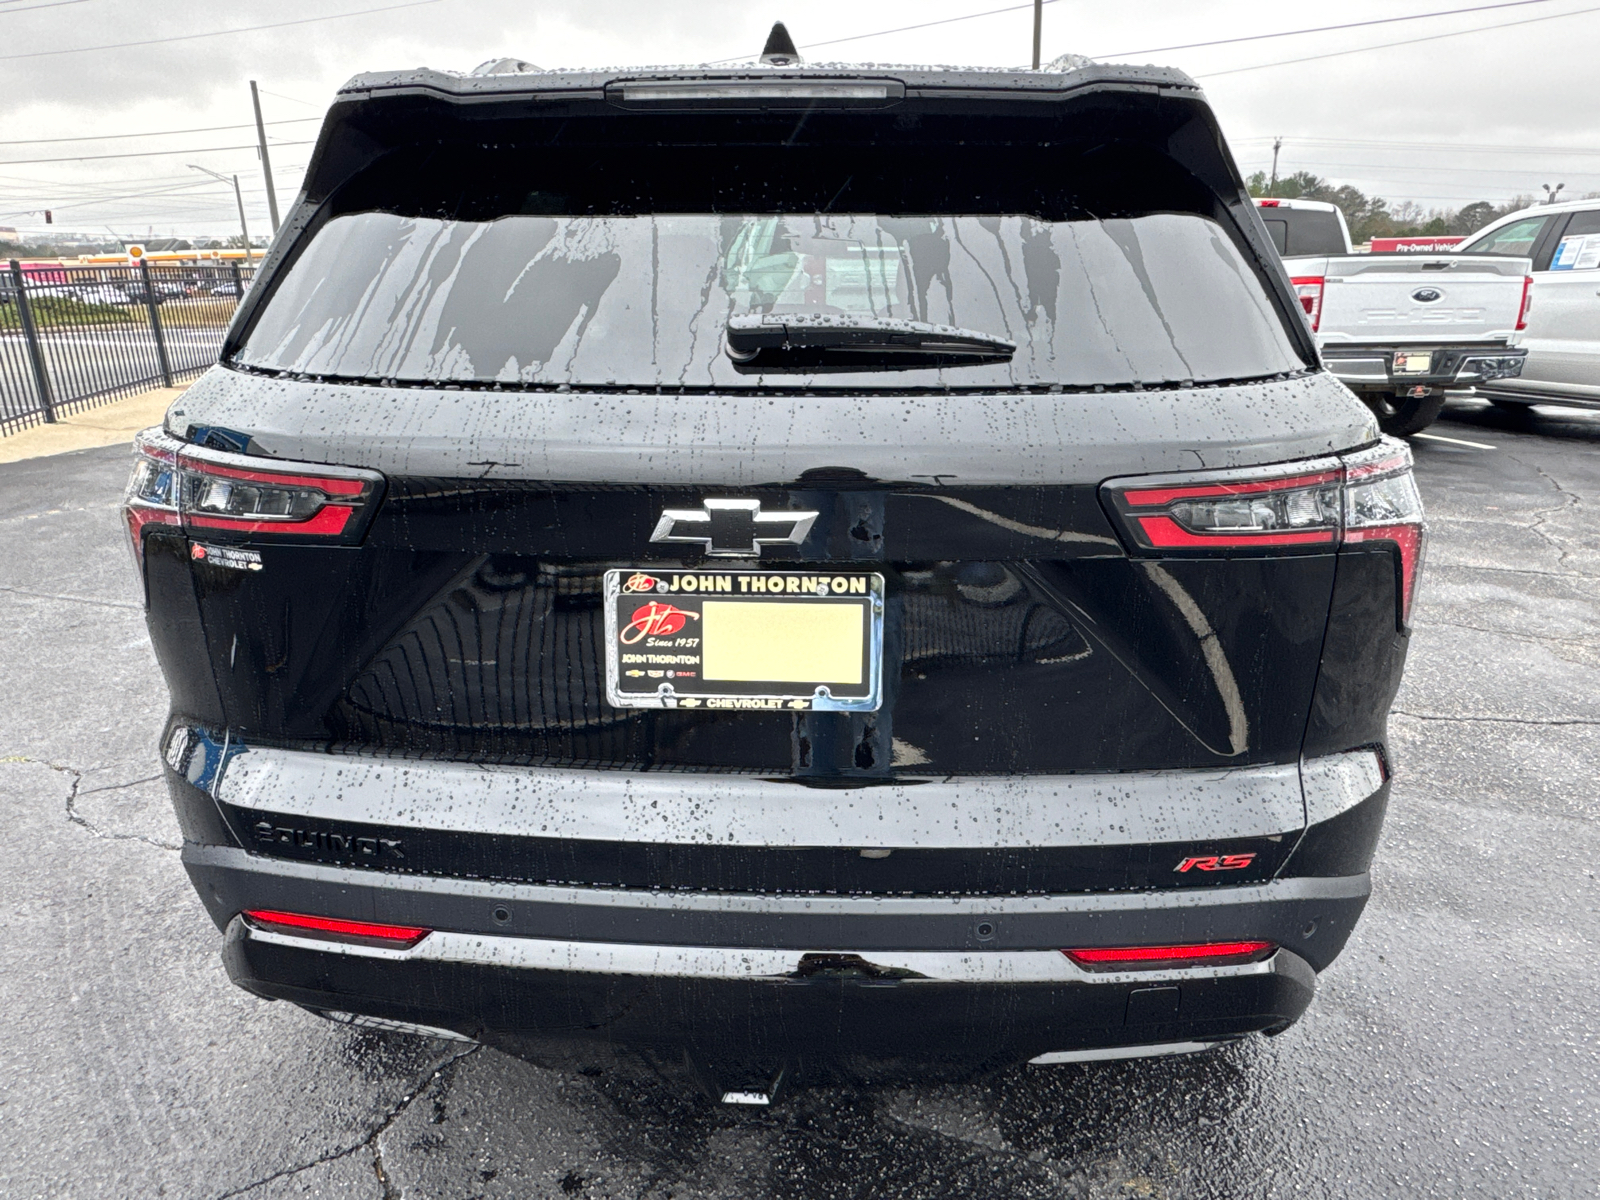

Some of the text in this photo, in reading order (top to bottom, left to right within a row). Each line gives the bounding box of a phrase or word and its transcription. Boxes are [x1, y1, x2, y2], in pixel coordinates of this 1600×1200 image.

[1396, 243, 1433, 252] Pre-Owned
[207, 546, 262, 562] JOHN THORNTON
[208, 556, 248, 570] CHEVROLET
[670, 575, 732, 592] JOHN
[738, 576, 867, 594] THORNTON
[646, 637, 700, 648] Since 1957
[622, 653, 700, 665] JOHN THORNTON
[706, 698, 784, 709] CHEVROLET
[255, 821, 405, 858] EQUINOX
[1173, 852, 1258, 873] RS
